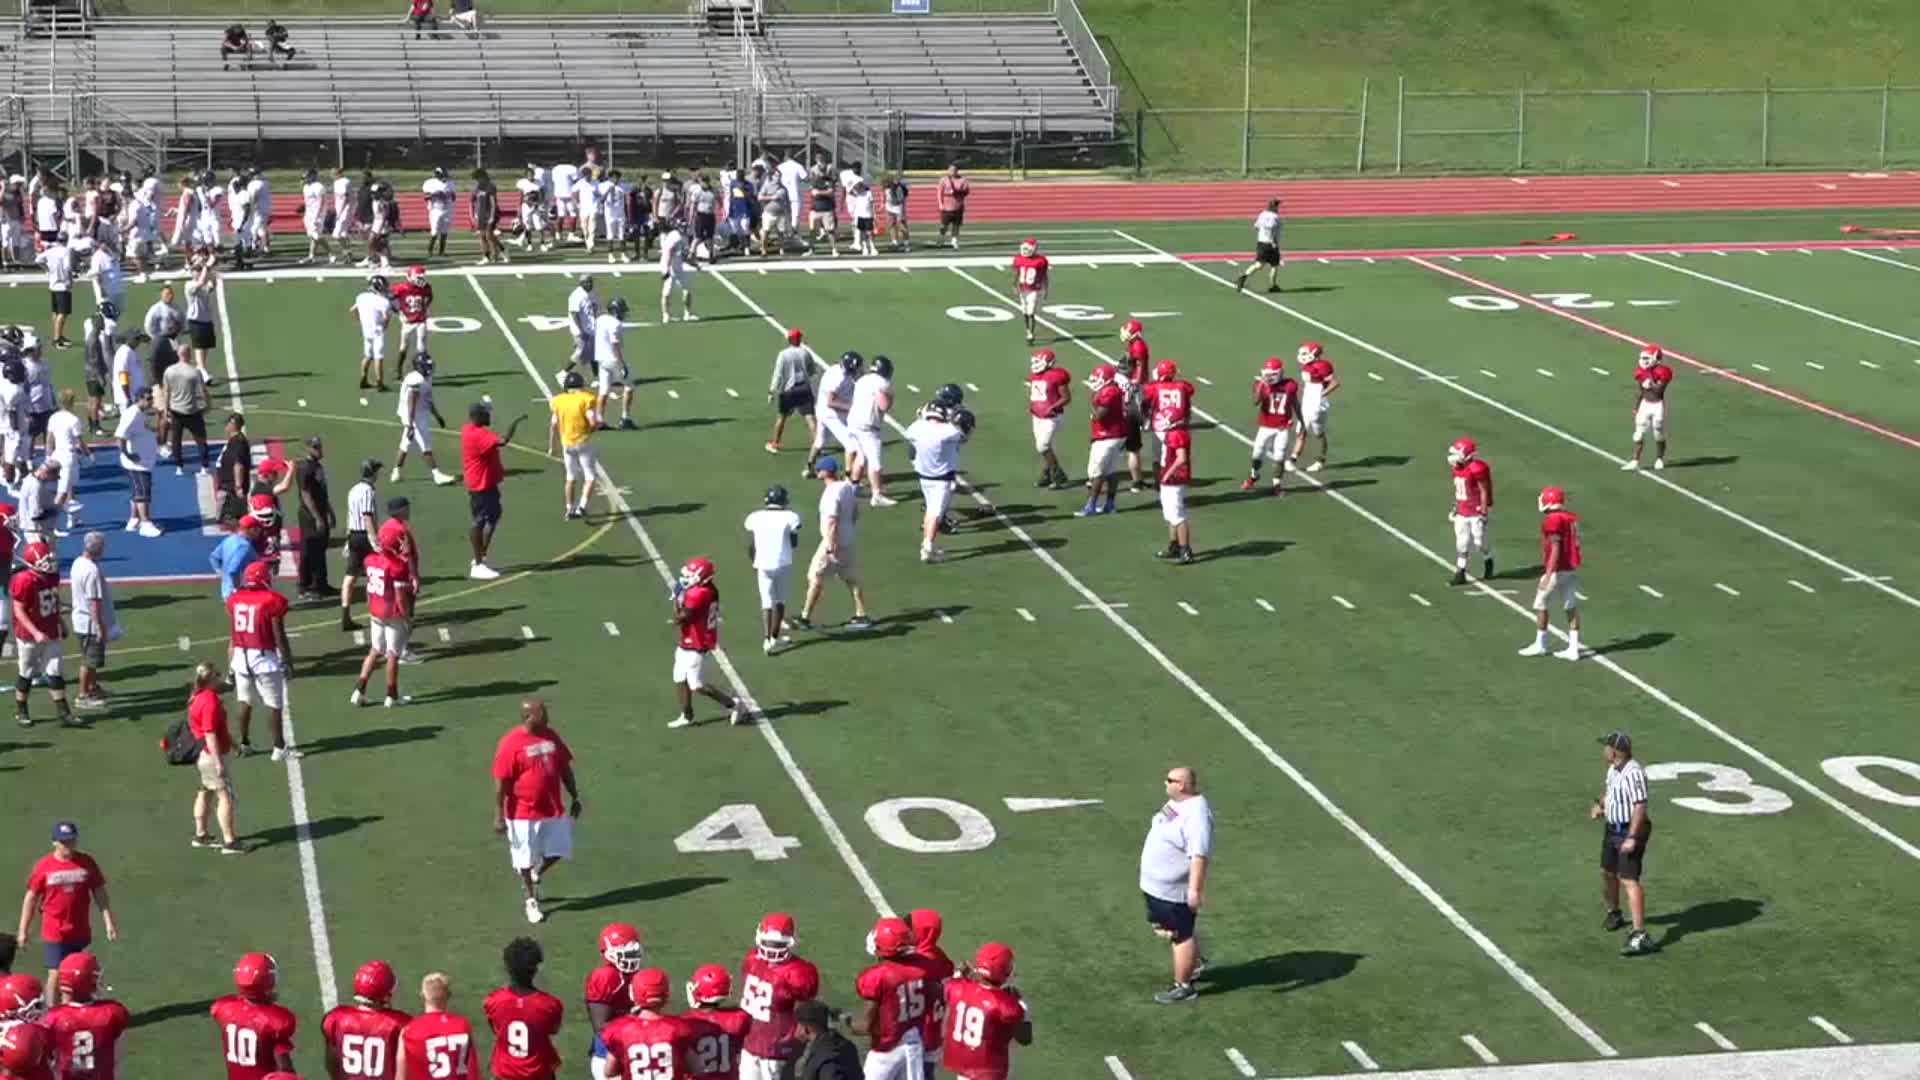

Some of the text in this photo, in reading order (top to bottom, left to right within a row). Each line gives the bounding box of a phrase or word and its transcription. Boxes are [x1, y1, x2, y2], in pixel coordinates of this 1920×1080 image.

[895, 978, 925, 1023] 15
[71, 1030, 95, 1069] 2
[225, 1023, 257, 1066] 10
[341, 1034, 386, 1077] 50
[425, 1034, 471, 1079] 57
[507, 1021, 529, 1058] 9
[697, 1033, 731, 1073] 21
[627, 1041, 674, 1080] 23
